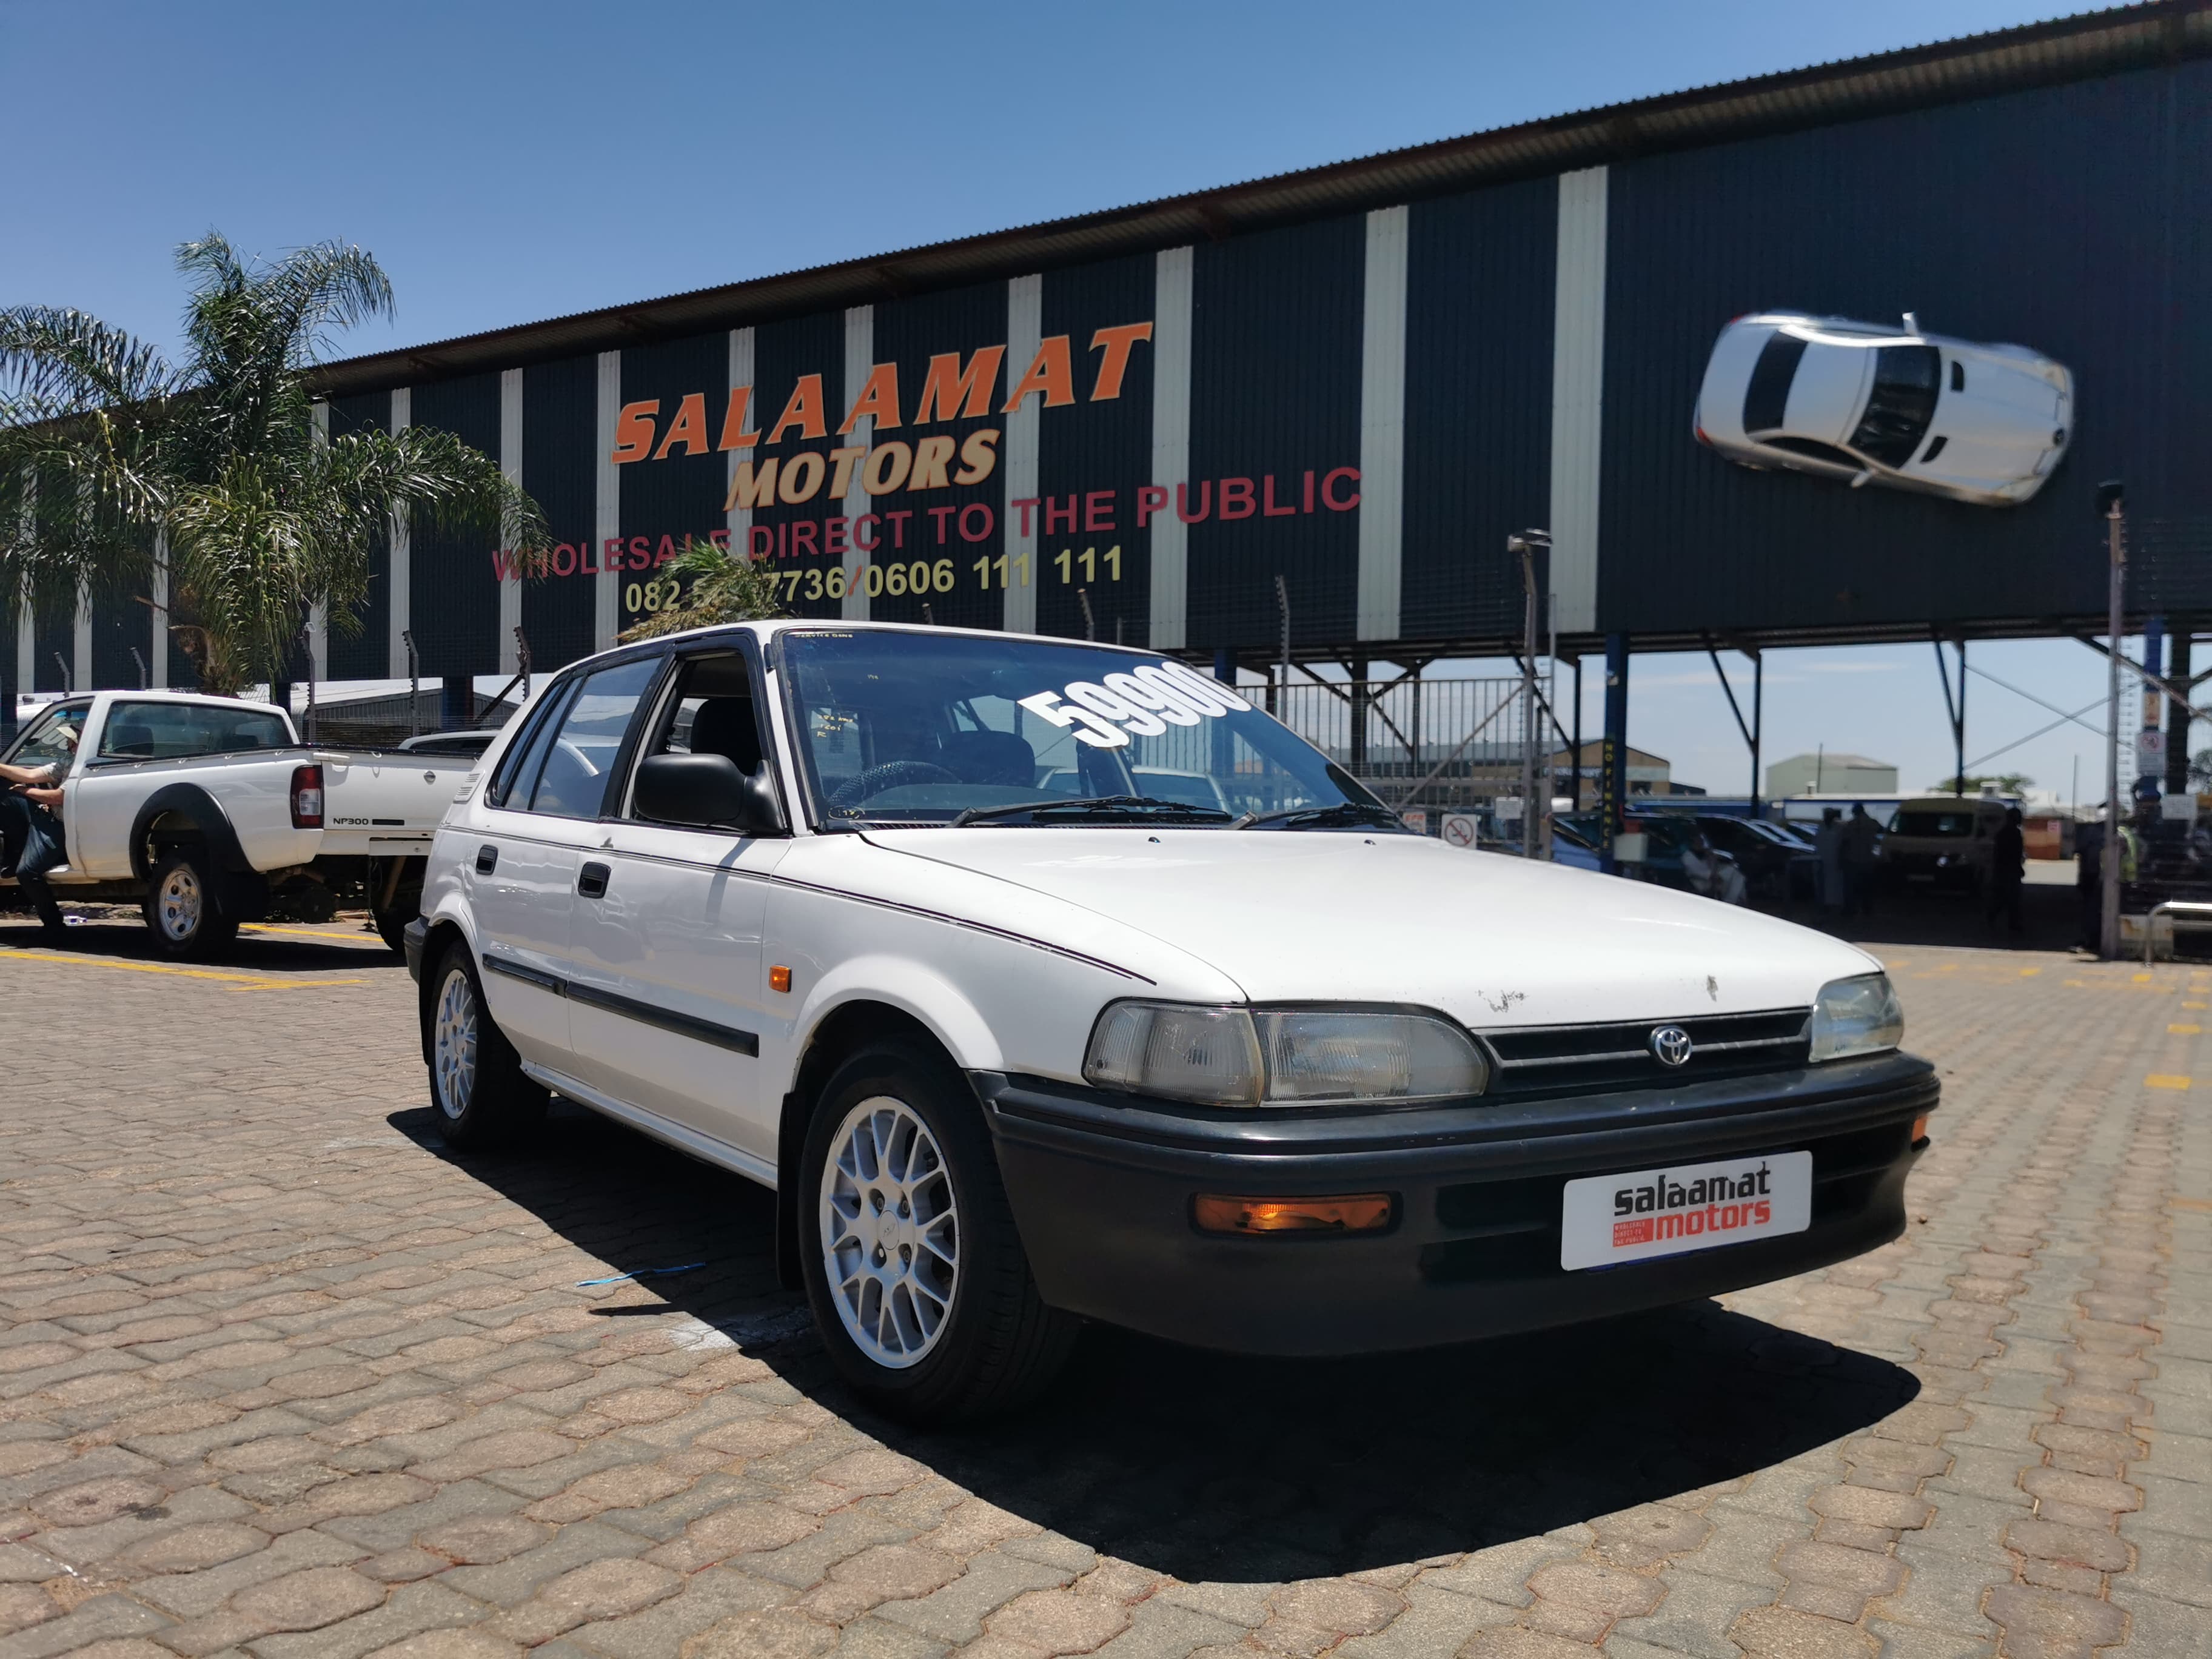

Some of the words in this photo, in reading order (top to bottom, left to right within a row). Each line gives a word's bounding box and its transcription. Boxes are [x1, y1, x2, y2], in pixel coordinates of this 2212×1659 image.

[611, 321, 1153, 464] SALAAMAT
[723, 428, 1001, 511] MOTORS
[749, 509, 913, 561] DIRECT
[928, 503, 994, 545] TO
[1011, 490, 1116, 538] THE
[1137, 466, 1361, 528] PUBLIC
[625, 580, 681, 612] 082
[973, 552, 1030, 590] 111
[1054, 545, 1121, 585] 111
[1016, 661, 1252, 748] 59900
[1614, 1161, 1771, 1216] salaamat
[1656, 1199, 1771, 1241] motors
